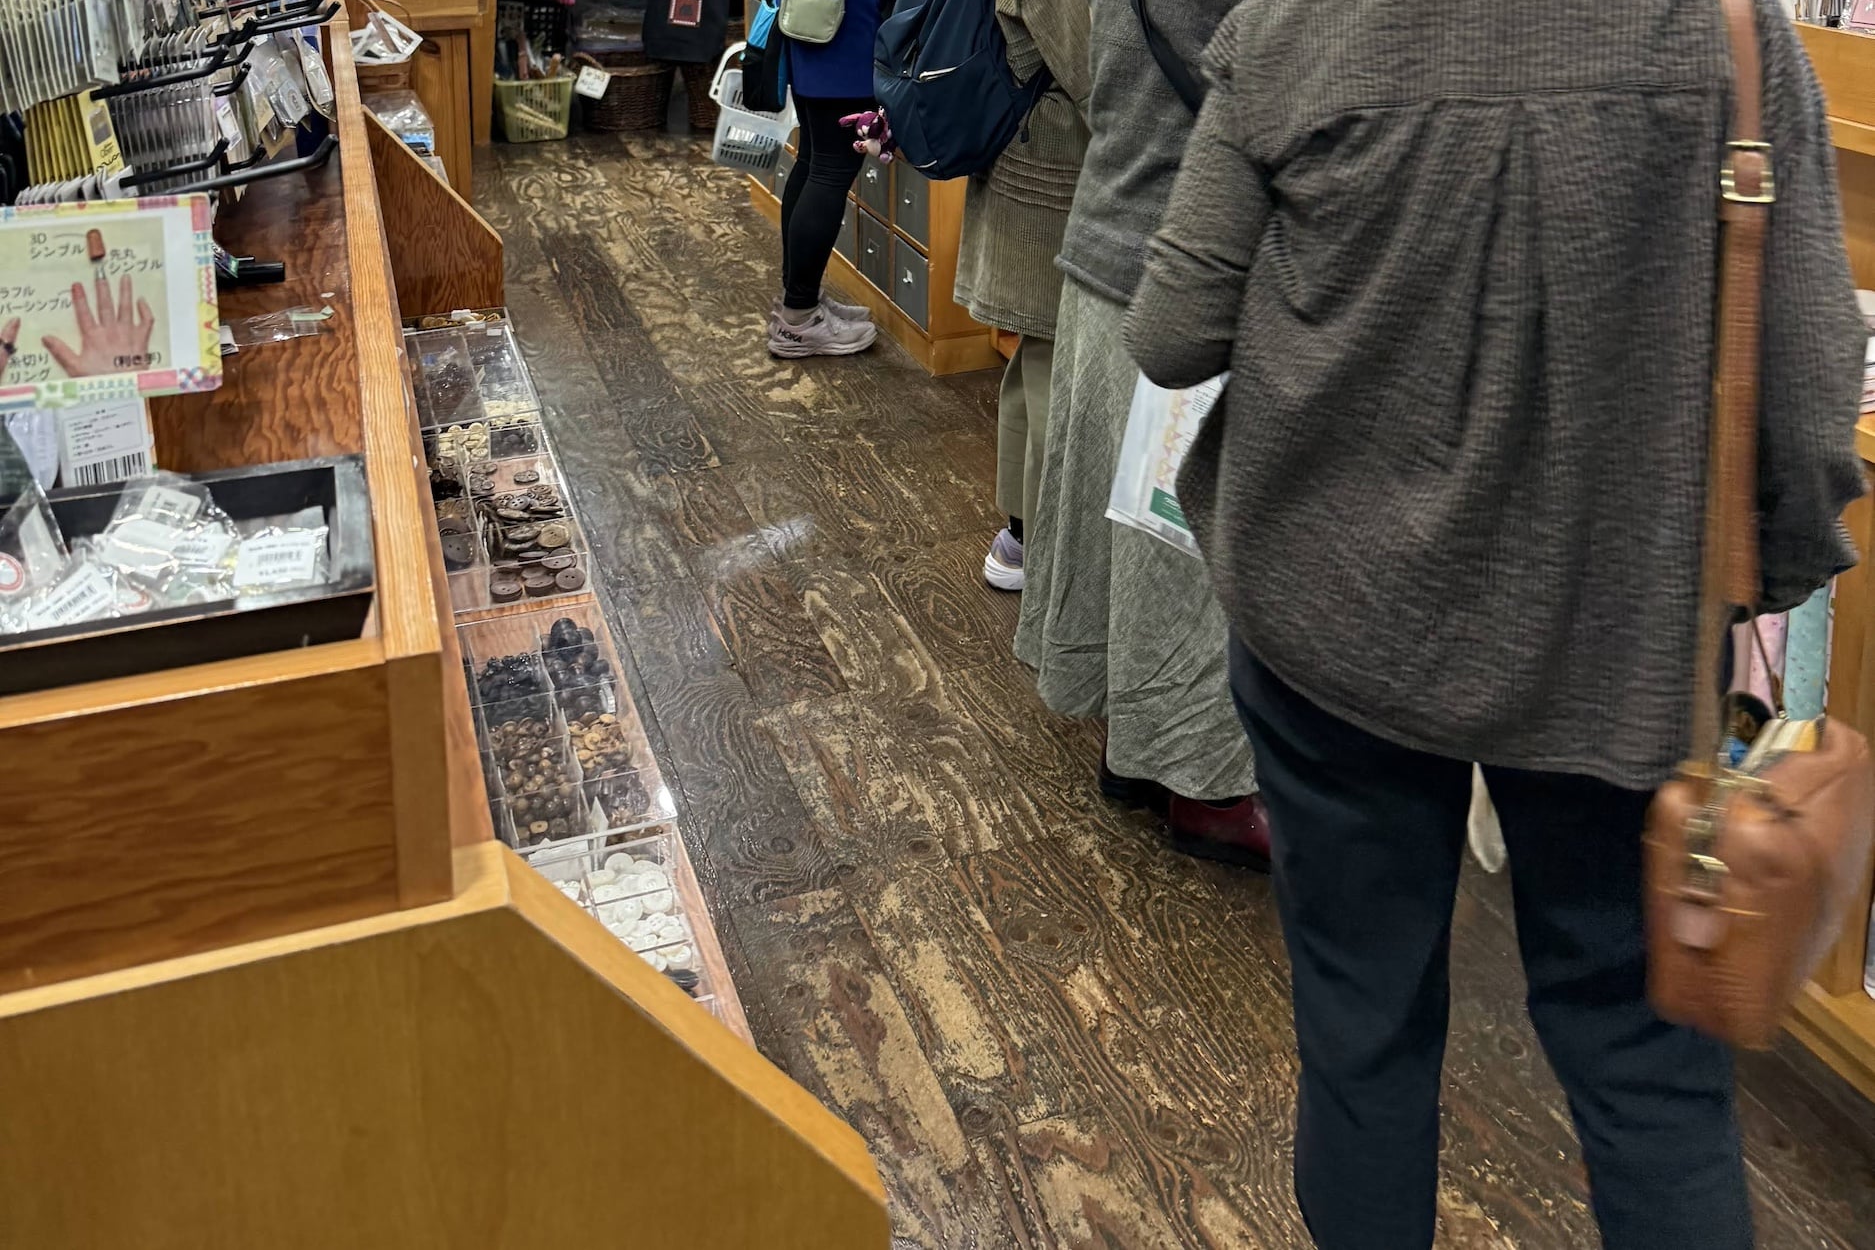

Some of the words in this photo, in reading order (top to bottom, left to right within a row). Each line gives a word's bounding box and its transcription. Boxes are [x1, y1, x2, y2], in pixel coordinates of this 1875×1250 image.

[30, 232, 47, 244] 3D
[777, 328, 803, 342] HOKA
[8, 352, 49, 369] 糸切り
[9, 368, 51, 384] リング
